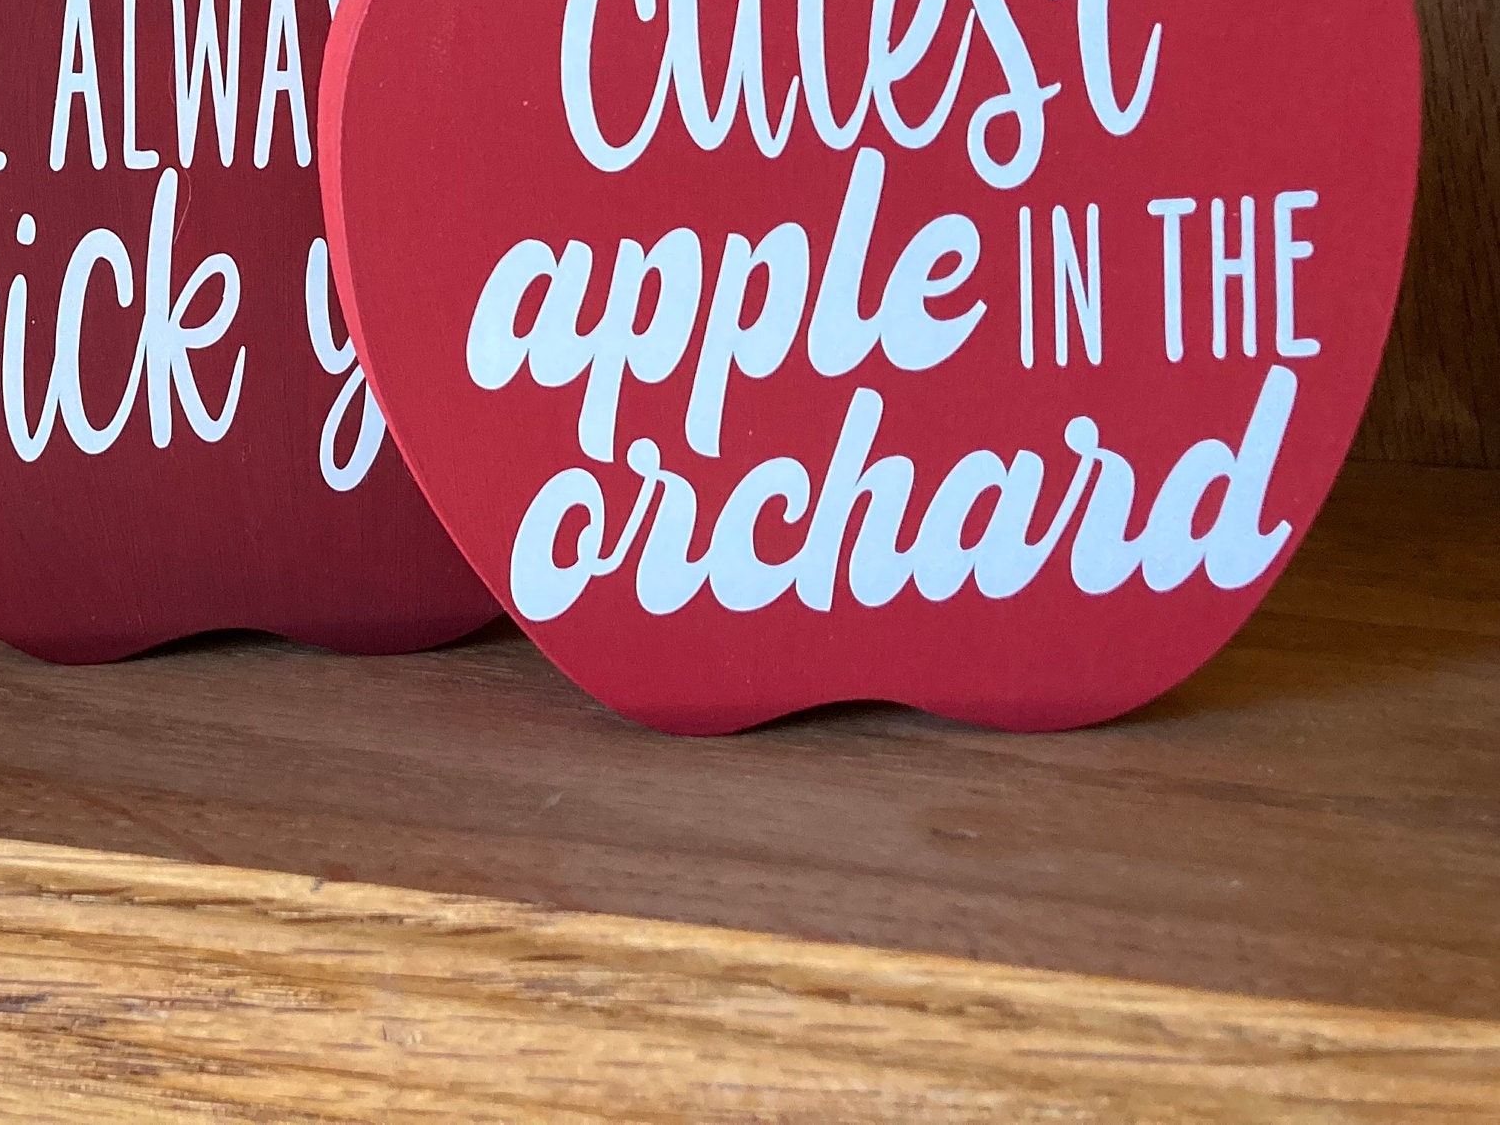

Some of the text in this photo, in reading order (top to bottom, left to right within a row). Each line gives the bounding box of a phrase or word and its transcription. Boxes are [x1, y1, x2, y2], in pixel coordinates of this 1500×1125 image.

[465, 146, 1323, 463] apple IN THE
[509, 364, 1298, 622] orchard
